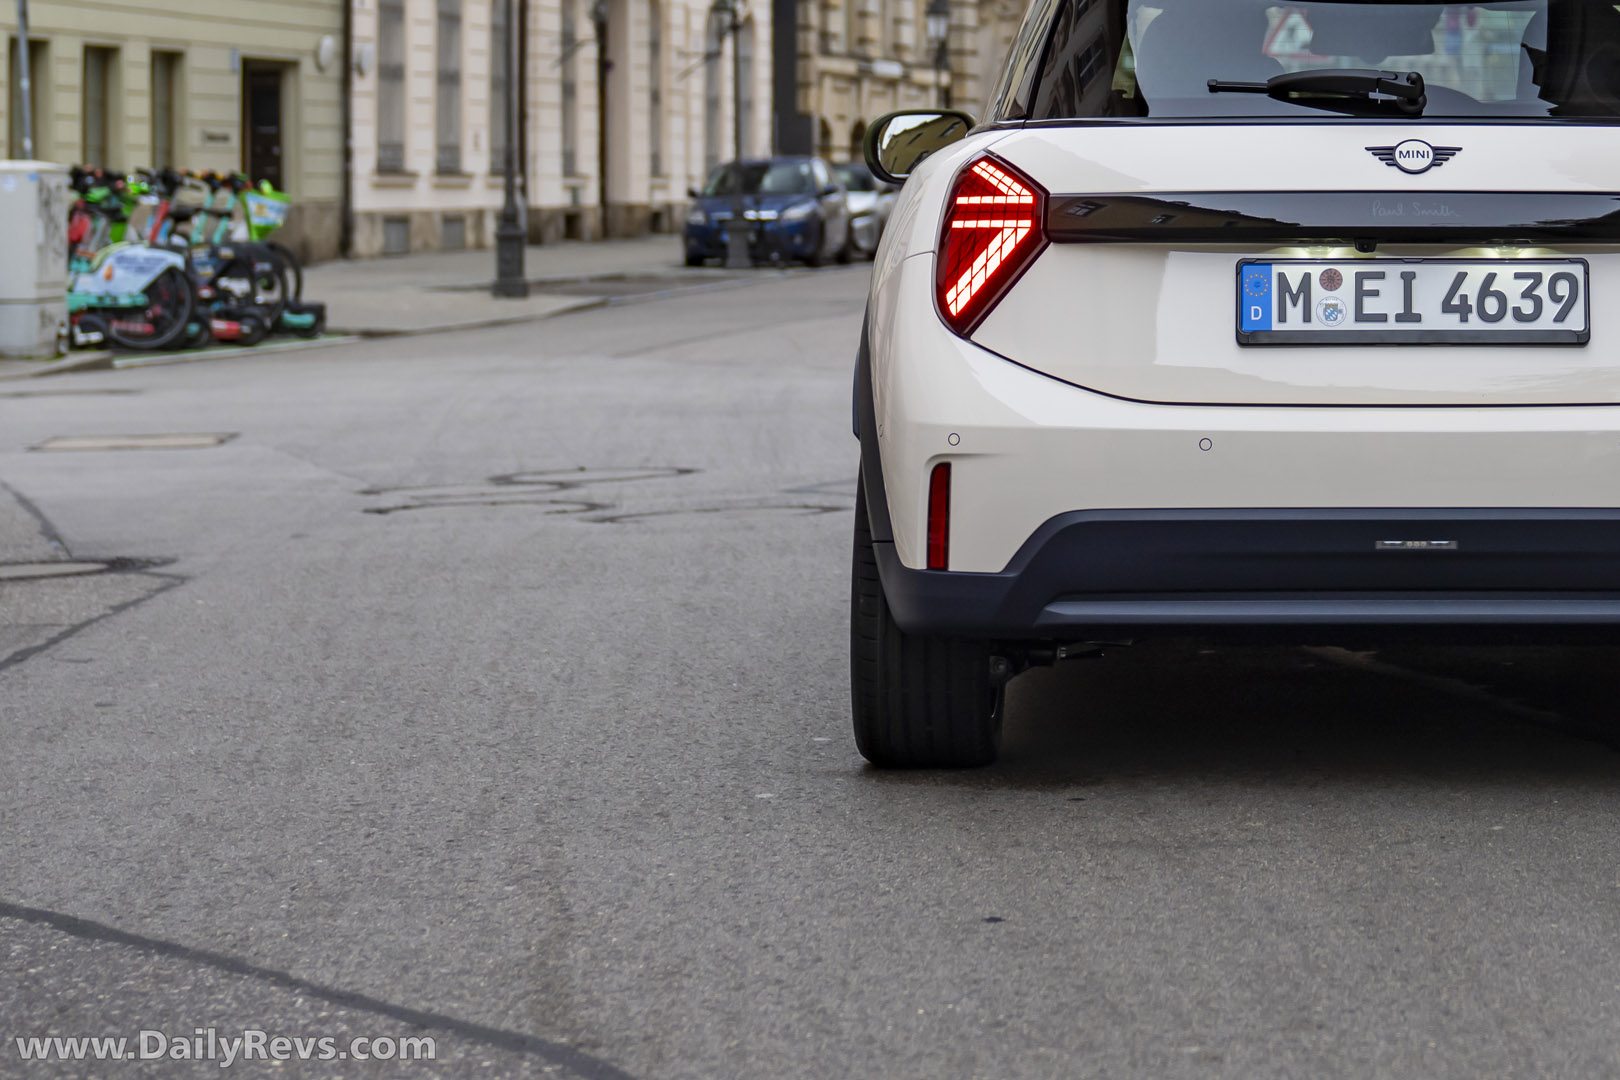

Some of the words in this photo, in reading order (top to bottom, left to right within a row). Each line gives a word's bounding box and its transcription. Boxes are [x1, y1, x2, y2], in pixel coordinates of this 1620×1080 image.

[1398, 150, 1430, 159] MINI
[1372, 200, 1404, 217] Paul
[1412, 201, 1461, 217] Smith
[1278, 271, 1312, 323] M
[1354, 271, 1422, 323] EI
[1441, 271, 1579, 323] 4639
[1251, 305, 1263, 320] D
